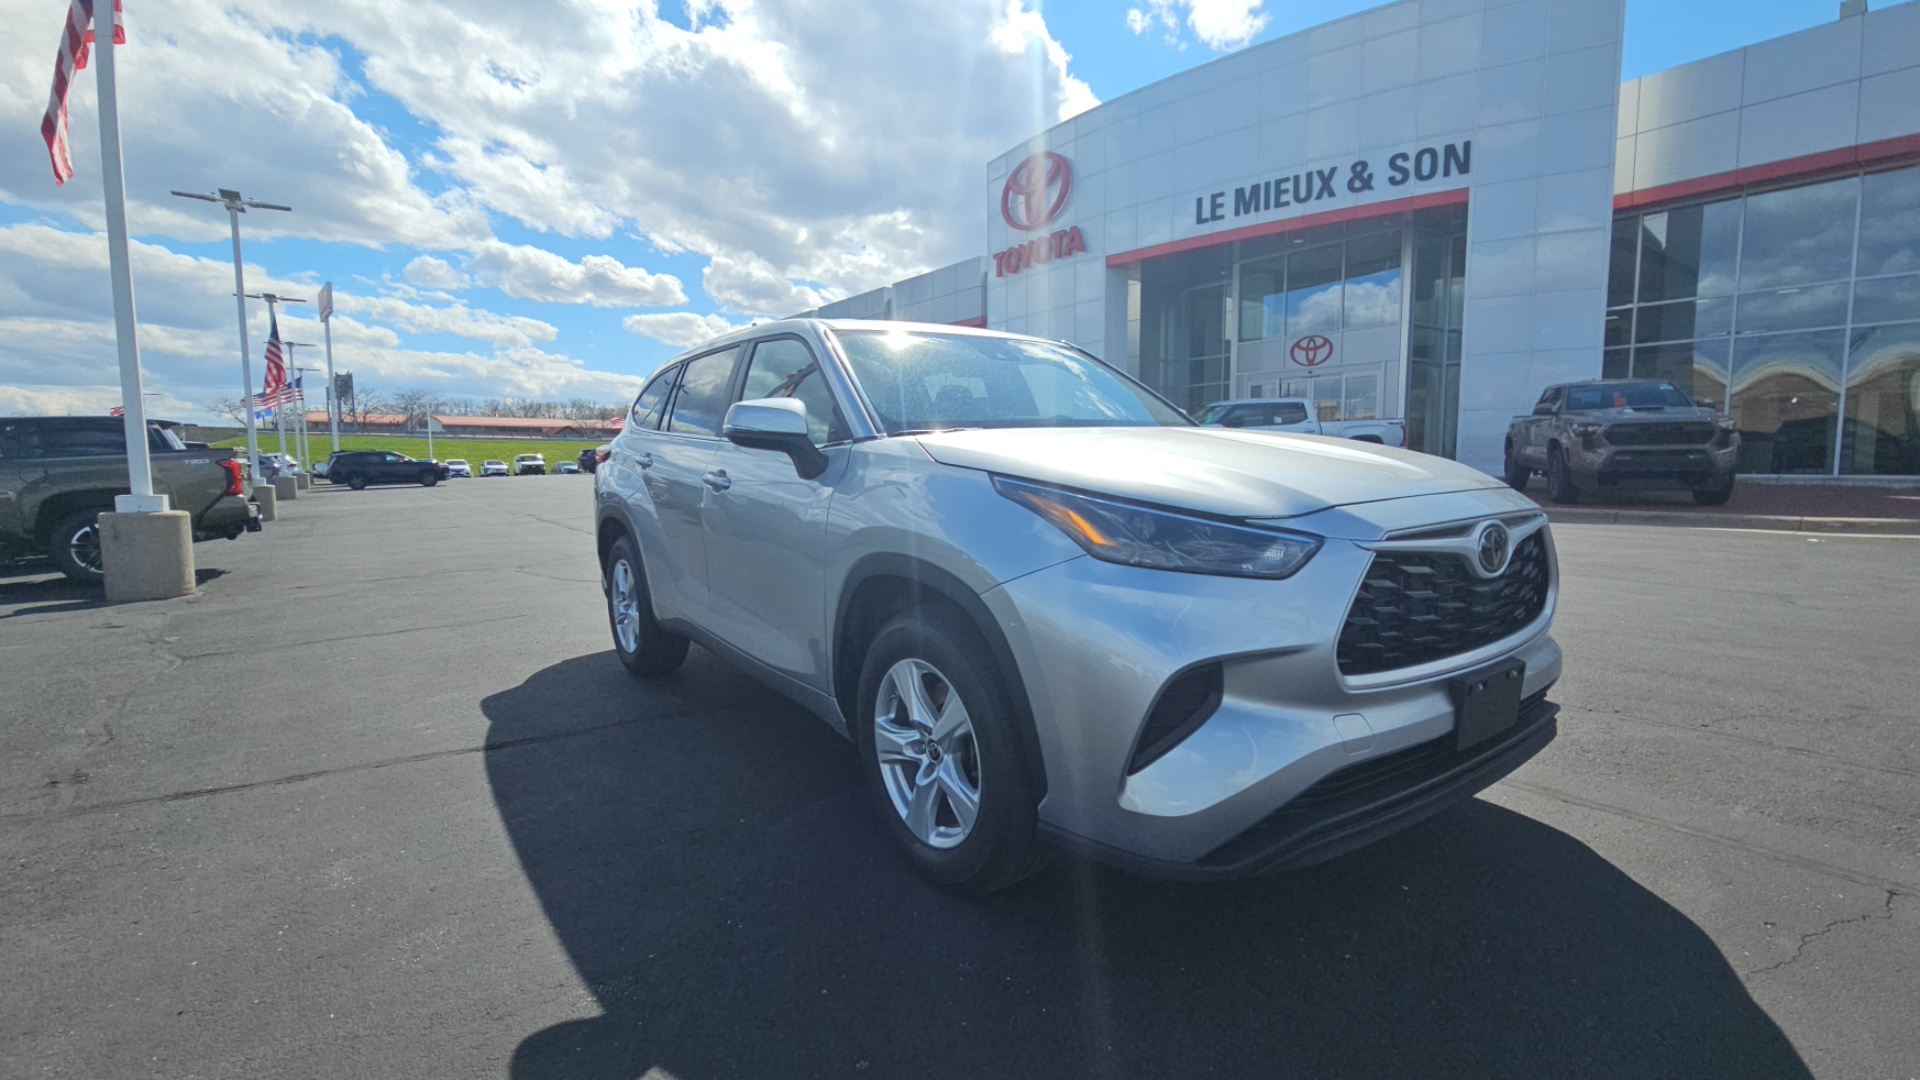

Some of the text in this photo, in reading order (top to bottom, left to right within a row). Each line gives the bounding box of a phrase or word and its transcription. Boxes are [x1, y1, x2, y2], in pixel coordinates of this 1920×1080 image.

[1196, 140, 1471, 225] LE MIEUX & SON
[992, 225, 1086, 277] TOYOTA
